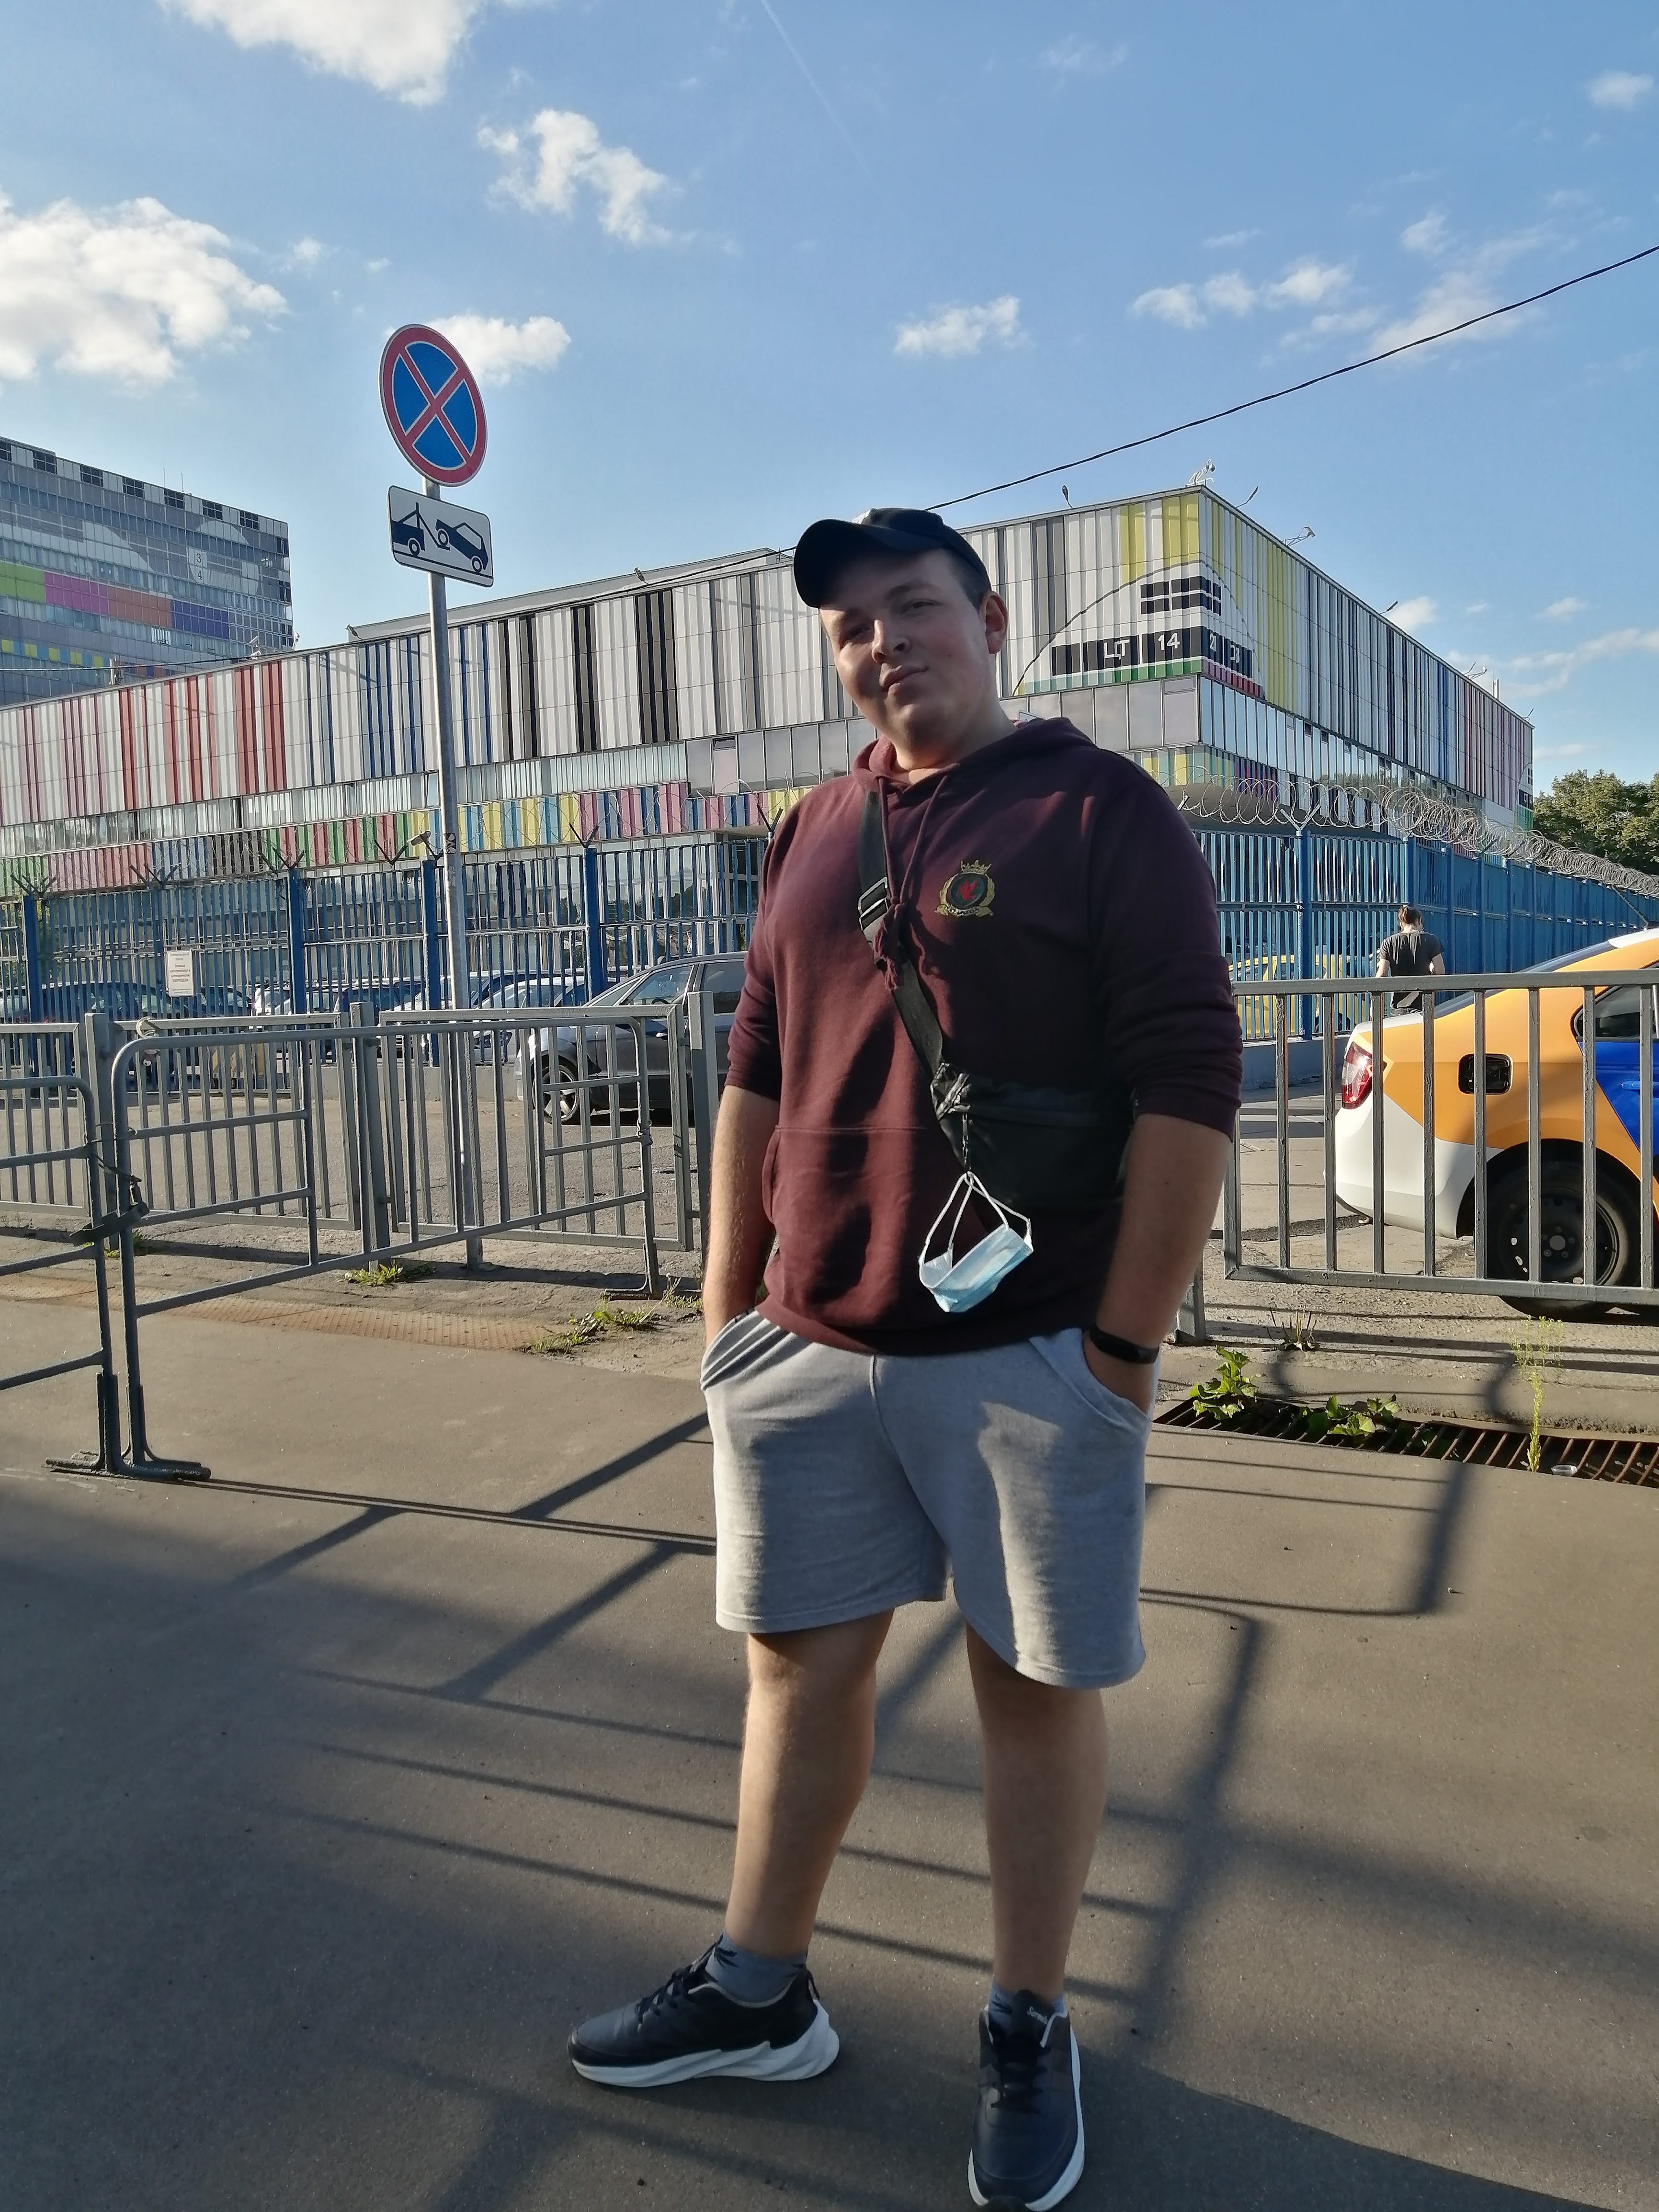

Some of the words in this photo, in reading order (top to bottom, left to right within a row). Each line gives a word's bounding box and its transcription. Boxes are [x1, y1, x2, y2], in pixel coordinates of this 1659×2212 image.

[196, 553, 202, 563] 3
[197, 570, 203, 581] 4
[1158, 632, 1181, 651] 14
